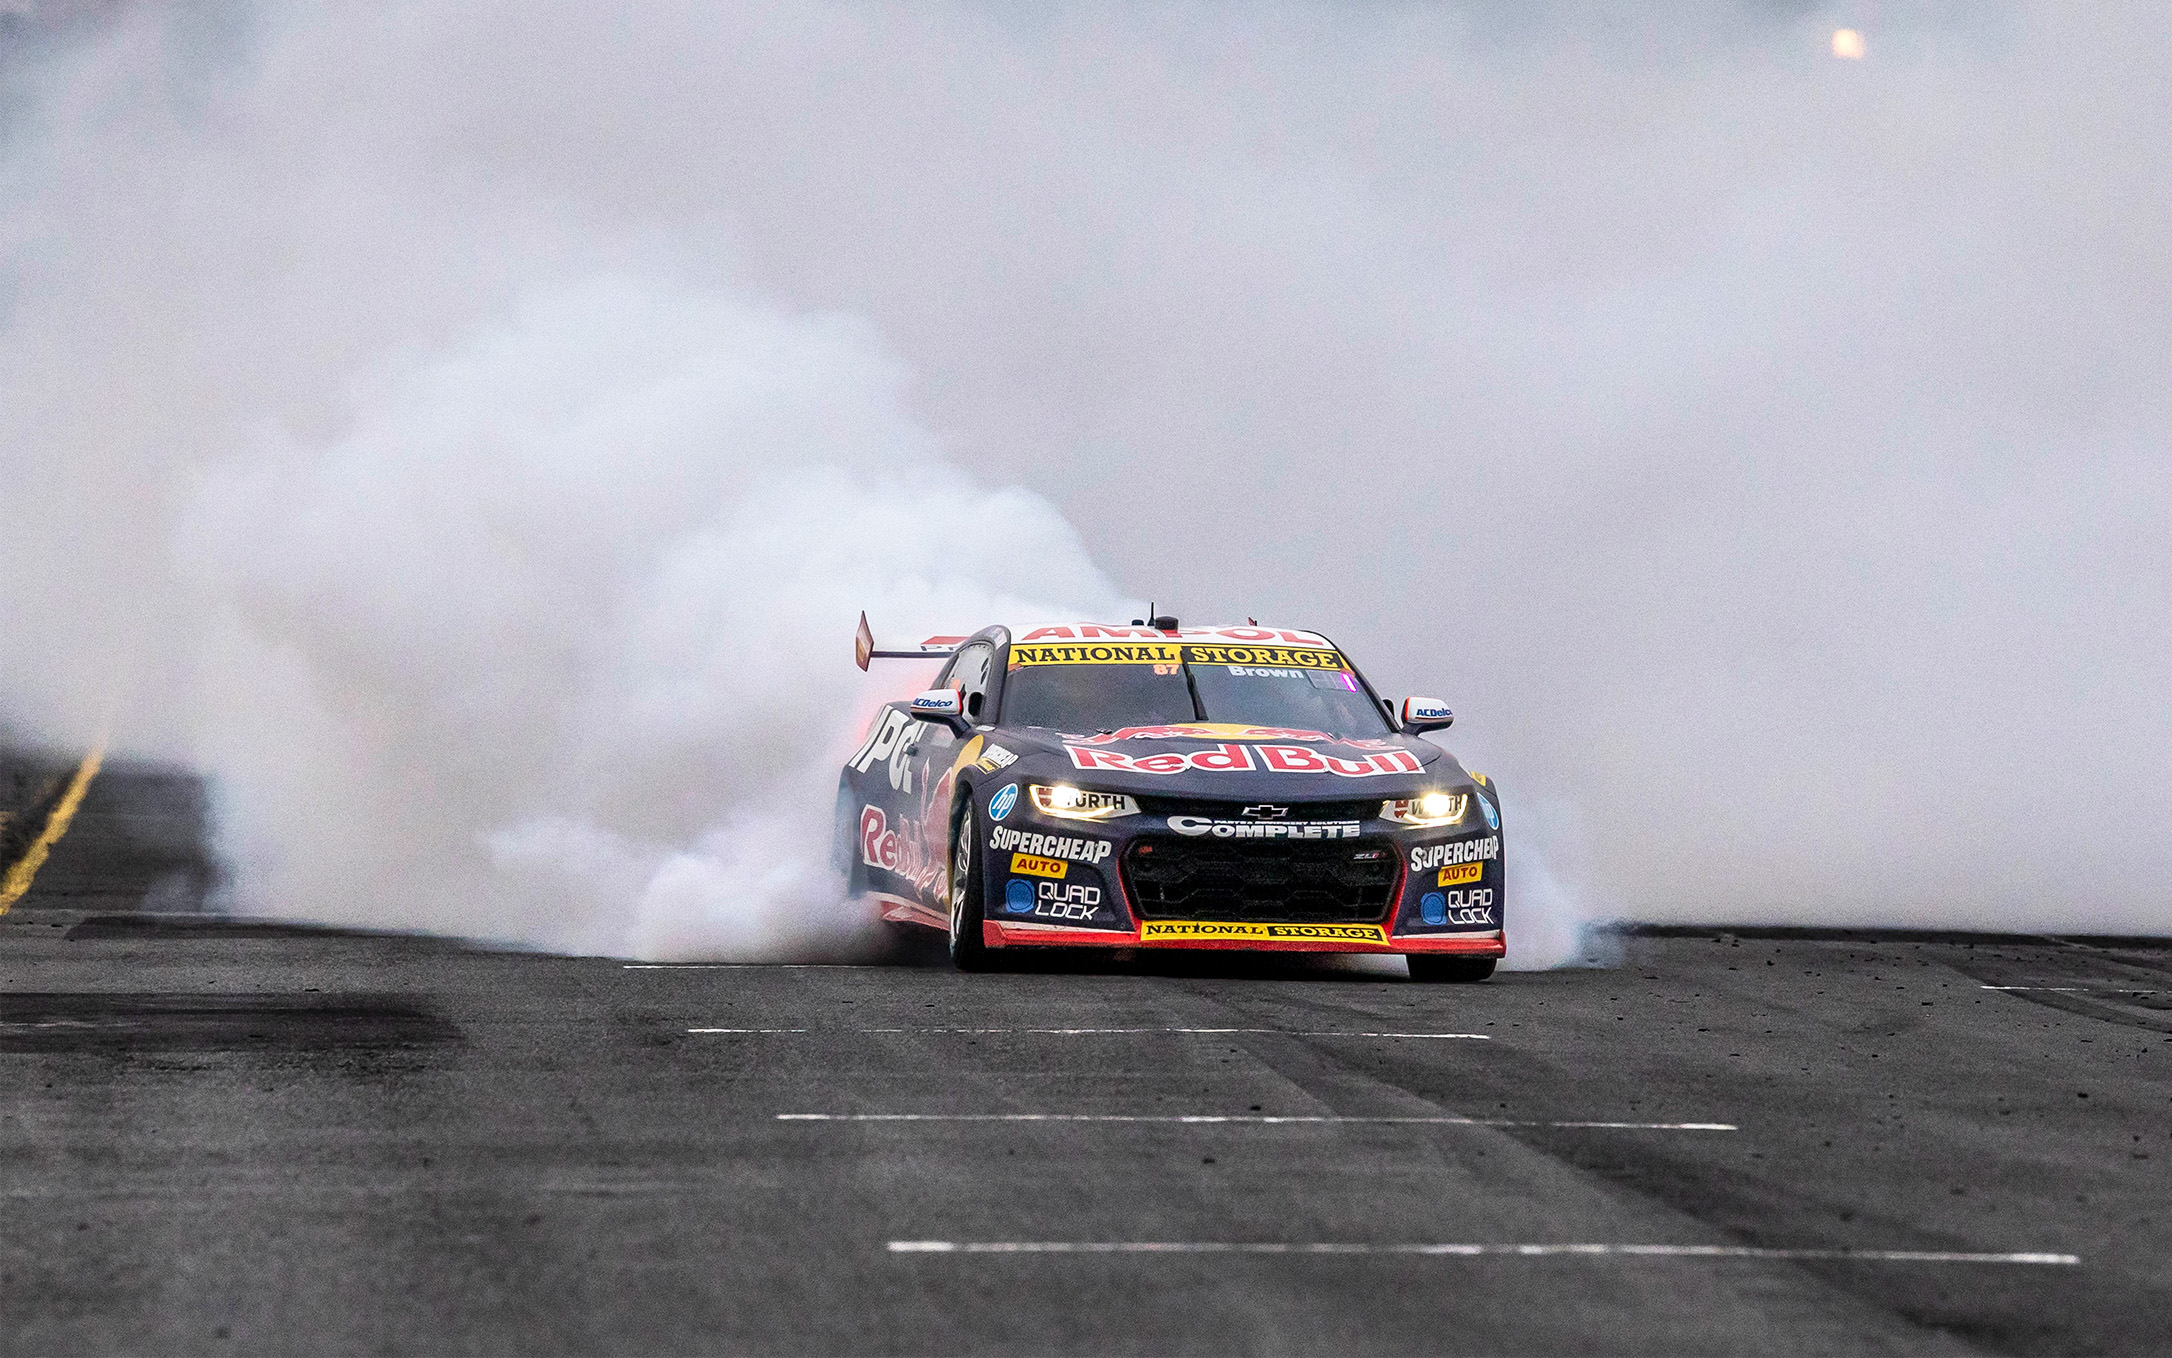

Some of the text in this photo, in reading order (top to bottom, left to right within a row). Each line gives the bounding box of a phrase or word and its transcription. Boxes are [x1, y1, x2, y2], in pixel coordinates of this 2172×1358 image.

[1016, 645, 1339, 669] NATIONAL STORAGE
[1153, 664, 1179, 675] 87
[1228, 665, 1304, 679] Brown
[1063, 743, 1426, 778] Red Bull
[990, 784, 1016, 820] hp
[1067, 793, 1126, 810] ÜRTH
[1412, 795, 1462, 815] WTH
[1167, 816, 1360, 838] COMPLETE
[989, 825, 1112, 864] SUPERCHEAP
[1410, 835, 1499, 872] SUPERCHEAP
[1017, 858, 1061, 873] AUTO
[1442, 866, 1478, 882] AUTO
[1038, 881, 1101, 906] QUAD
[1448, 888, 1493, 909] QUAD
[1035, 900, 1100, 921] LOCK
[1448, 906, 1494, 925] LOCK
[1146, 924, 1378, 940] NATIONAL STORAGE
